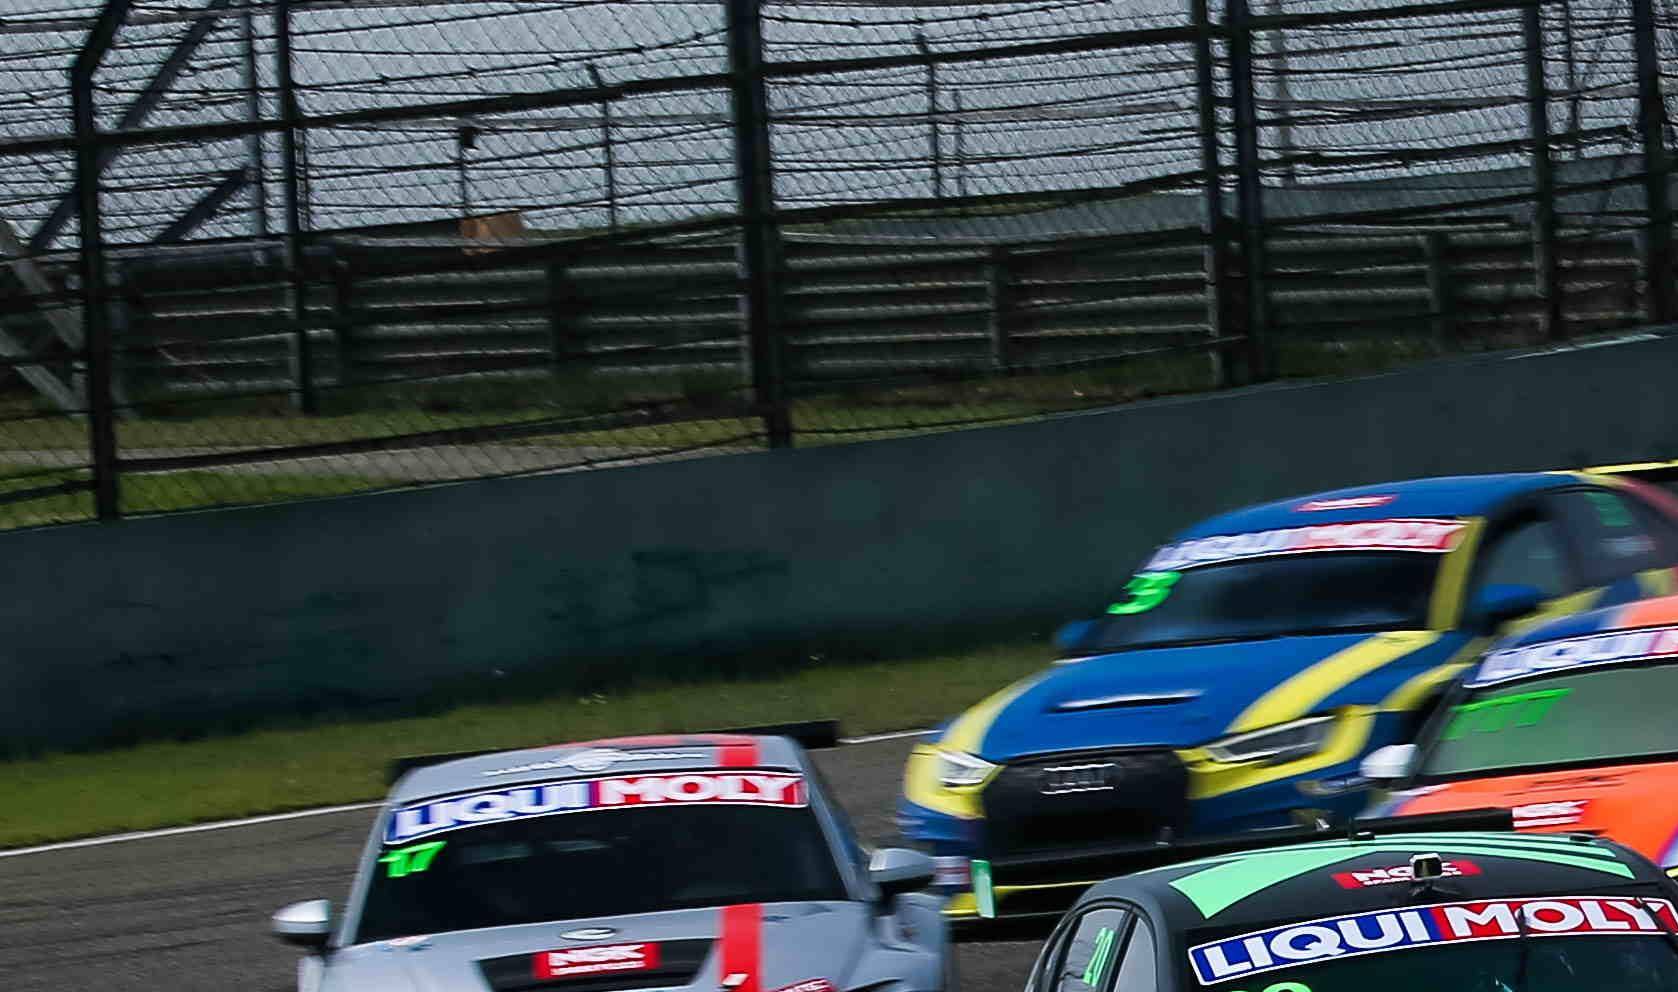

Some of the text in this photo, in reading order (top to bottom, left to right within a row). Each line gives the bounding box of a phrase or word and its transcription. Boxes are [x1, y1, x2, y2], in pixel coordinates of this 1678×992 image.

[1104, 570, 1184, 615] 3
[396, 775, 798, 838] LIQUI MOLY
[378, 841, 448, 878] 17
[1205, 900, 1662, 979] LIQUI MOLY
